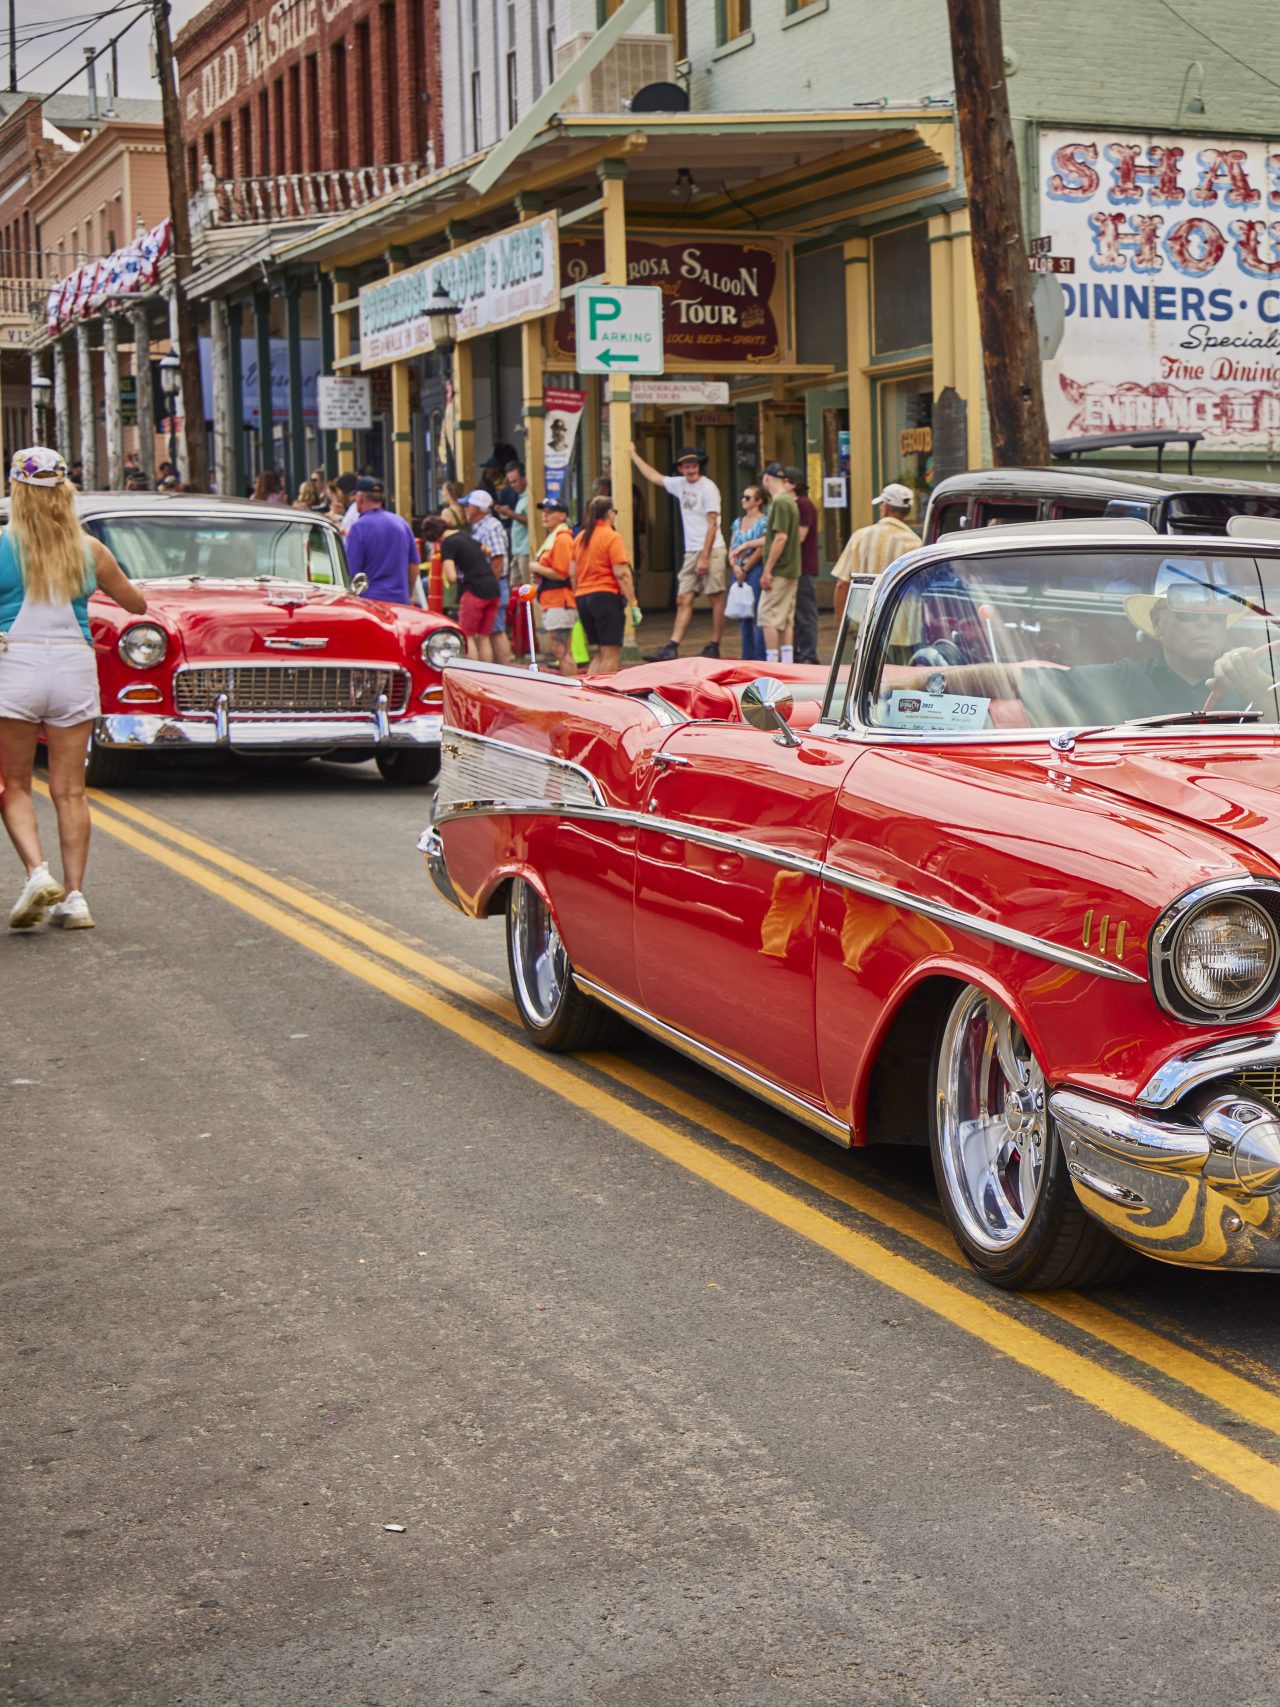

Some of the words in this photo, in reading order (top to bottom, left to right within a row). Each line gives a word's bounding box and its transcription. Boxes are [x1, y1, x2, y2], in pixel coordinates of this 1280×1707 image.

[203, 45, 238, 119] OLD
[681, 248, 760, 297] SALOON
[1028, 257, 1054, 272] YLOR
[1060, 259, 1071, 272] ST
[671, 297, 738, 325] TOUR
[1060, 283, 1234, 322] DINNERS
[588, 296, 653, 343] PARKING
[667, 335, 694, 344] LOCAL
[697, 335, 723, 344] BEER
[1161, 355, 1205, 381] Fine
[643, 384, 702, 393] UNDERGROUND
[900, 427, 932, 455] GRUB
[951, 702, 978, 716] 205
